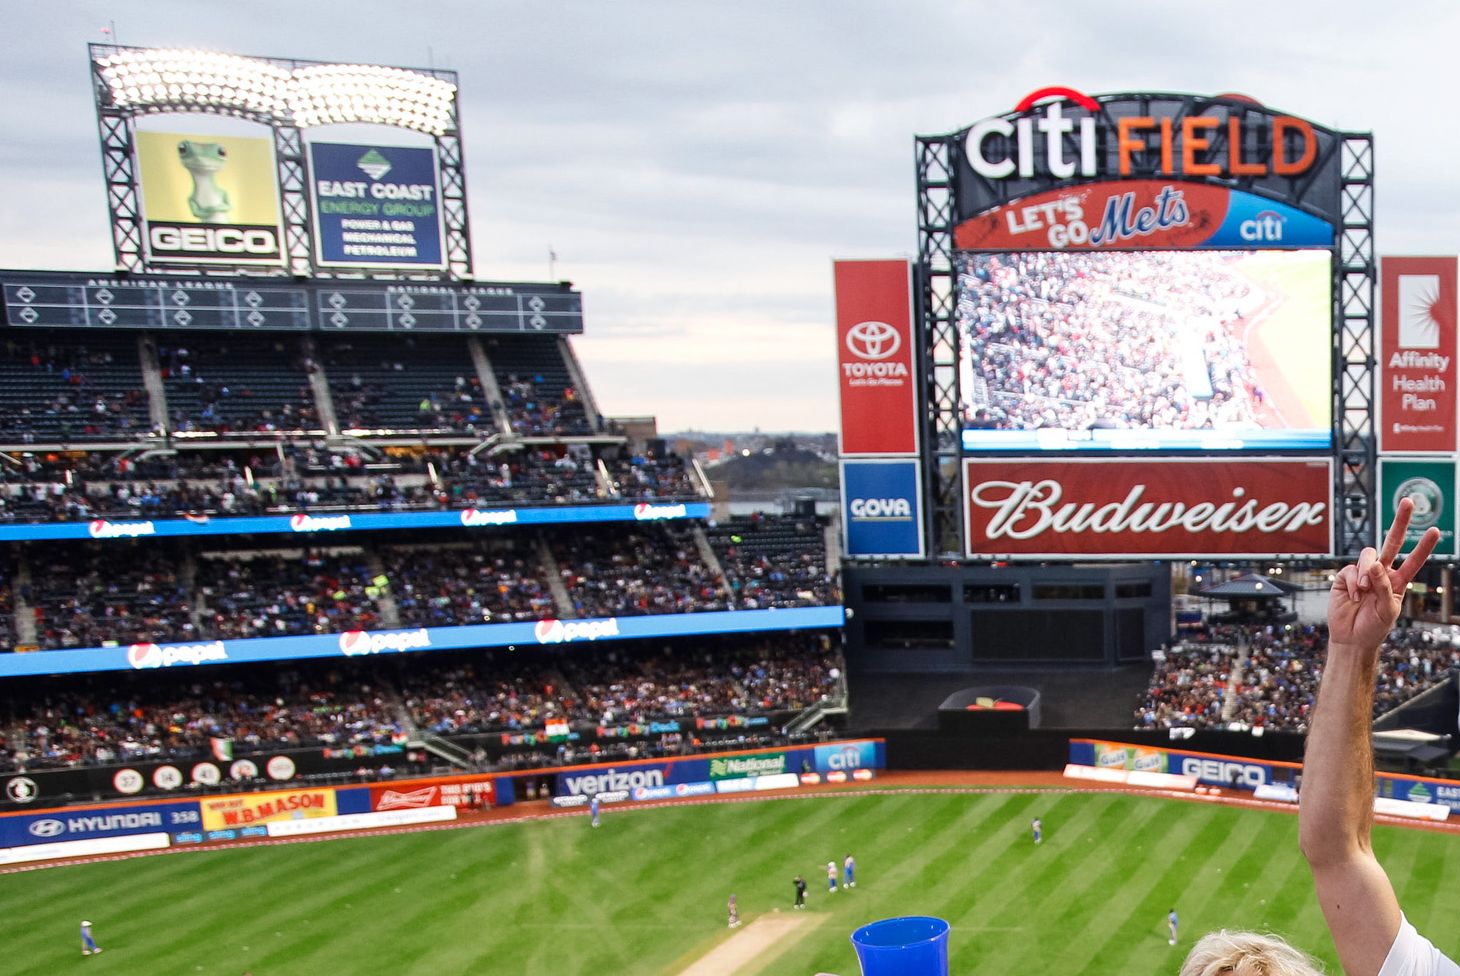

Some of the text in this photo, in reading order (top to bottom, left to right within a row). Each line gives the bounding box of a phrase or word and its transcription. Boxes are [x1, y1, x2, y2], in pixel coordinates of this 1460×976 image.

[1117, 115, 1318, 176] FIELD
[317, 180, 434, 201] EAST COAST
[320, 201, 434, 217] ENERGY GROUP
[1005, 197, 1084, 236] LET'S
[1047, 186, 1190, 249] GO Mets
[340, 219, 379, 232] POWER
[150, 226, 277, 254] GEICO
[342, 231, 417, 245] MECHANICAL
[343, 244, 418, 258] PETROLEUM
[87, 279, 234, 290] AMERICAN LEAGUE
[387, 286, 514, 297] NATIONAL LEAGUE
[841, 362, 908, 378] TOYOTA
[1388, 350, 1450, 373] Affinity
[1392, 374, 1446, 393] Health
[1401, 393, 1437, 412] Plan
[850, 498, 911, 519] GOYA
[971, 479, 1326, 539] Budweiser
[563, 617, 620, 641] pepsi
[368, 628, 432, 652] pepsi
[161, 641, 229, 666] pepsi
[727, 755, 786, 773] National
[565, 768, 664, 796] verizon
[67, 811, 162, 833] HYUNDAI
[171, 811, 200, 825] 358
